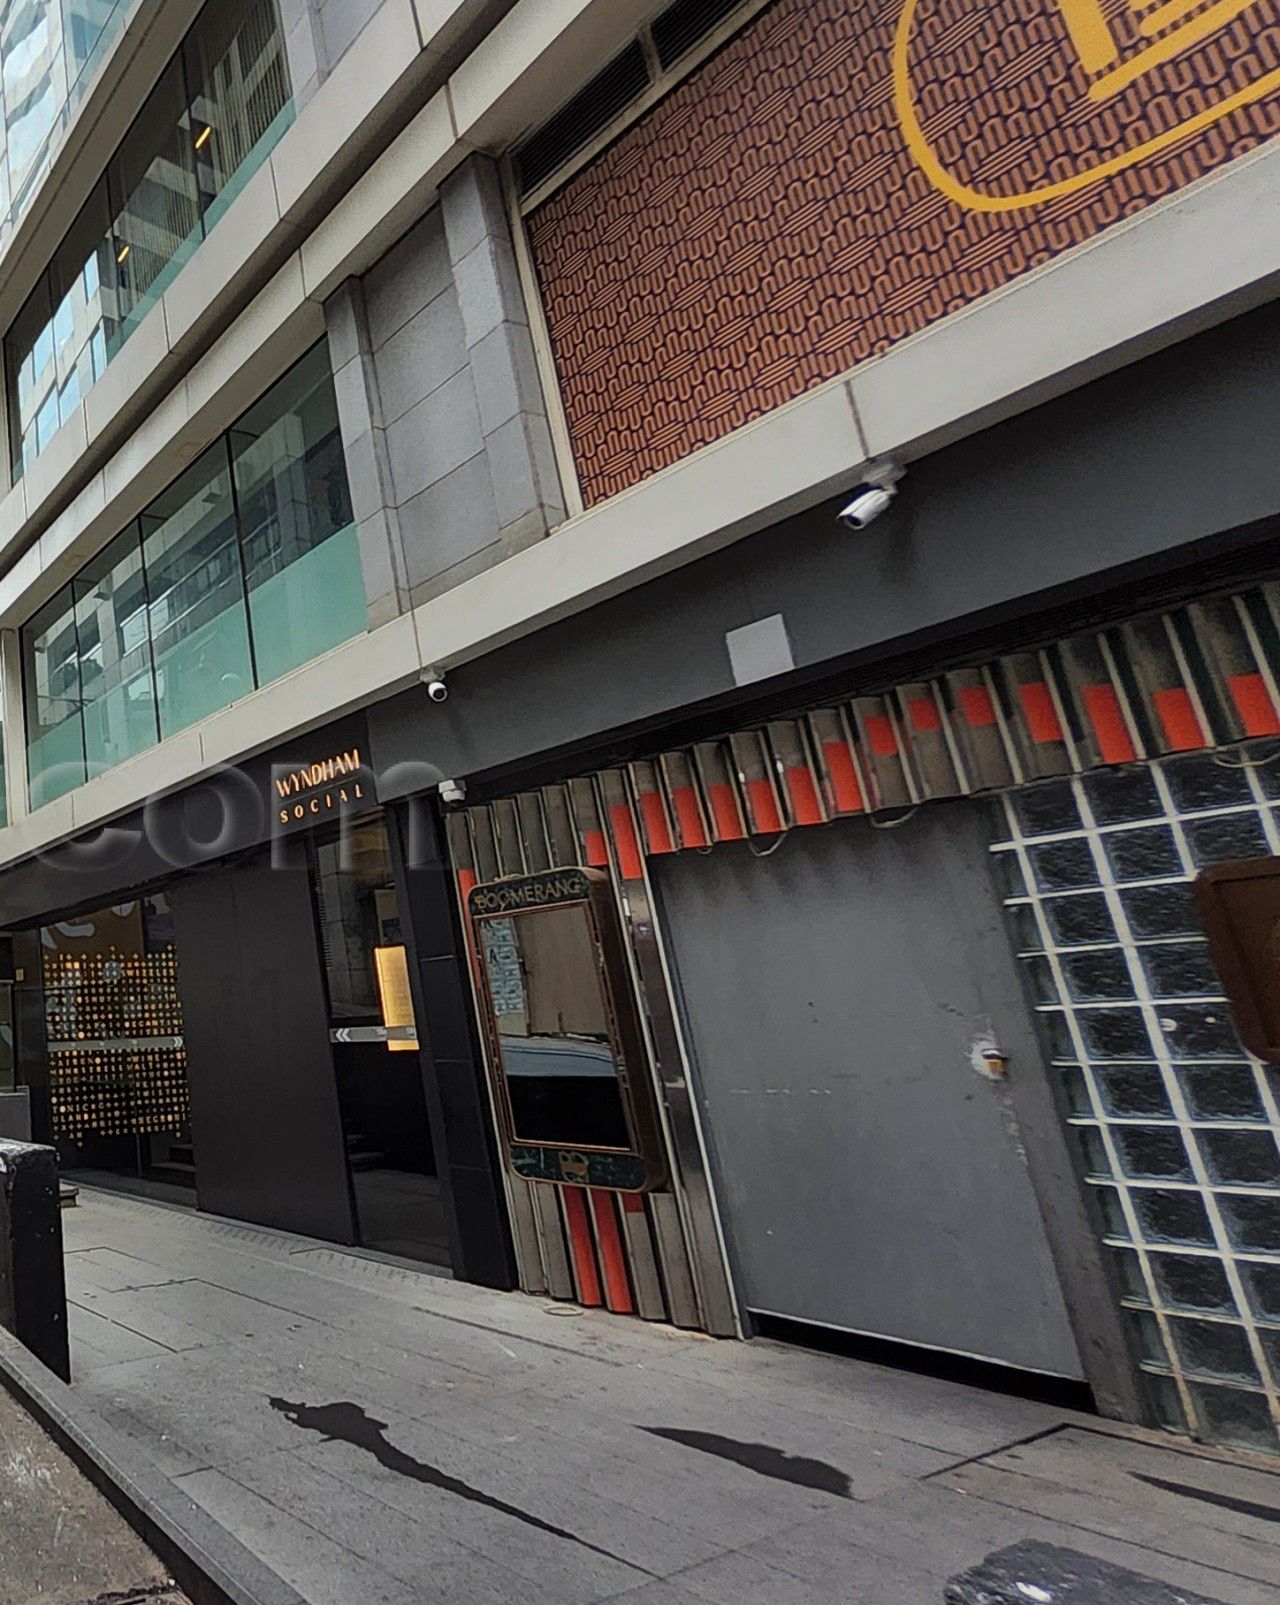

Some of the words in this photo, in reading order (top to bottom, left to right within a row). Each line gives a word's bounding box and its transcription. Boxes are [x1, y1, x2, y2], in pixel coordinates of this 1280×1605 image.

[276, 749, 360, 797] WYNDHAM
[280, 784, 363, 823] SOCIAL
[474, 877, 581, 910] BOOMERANG
